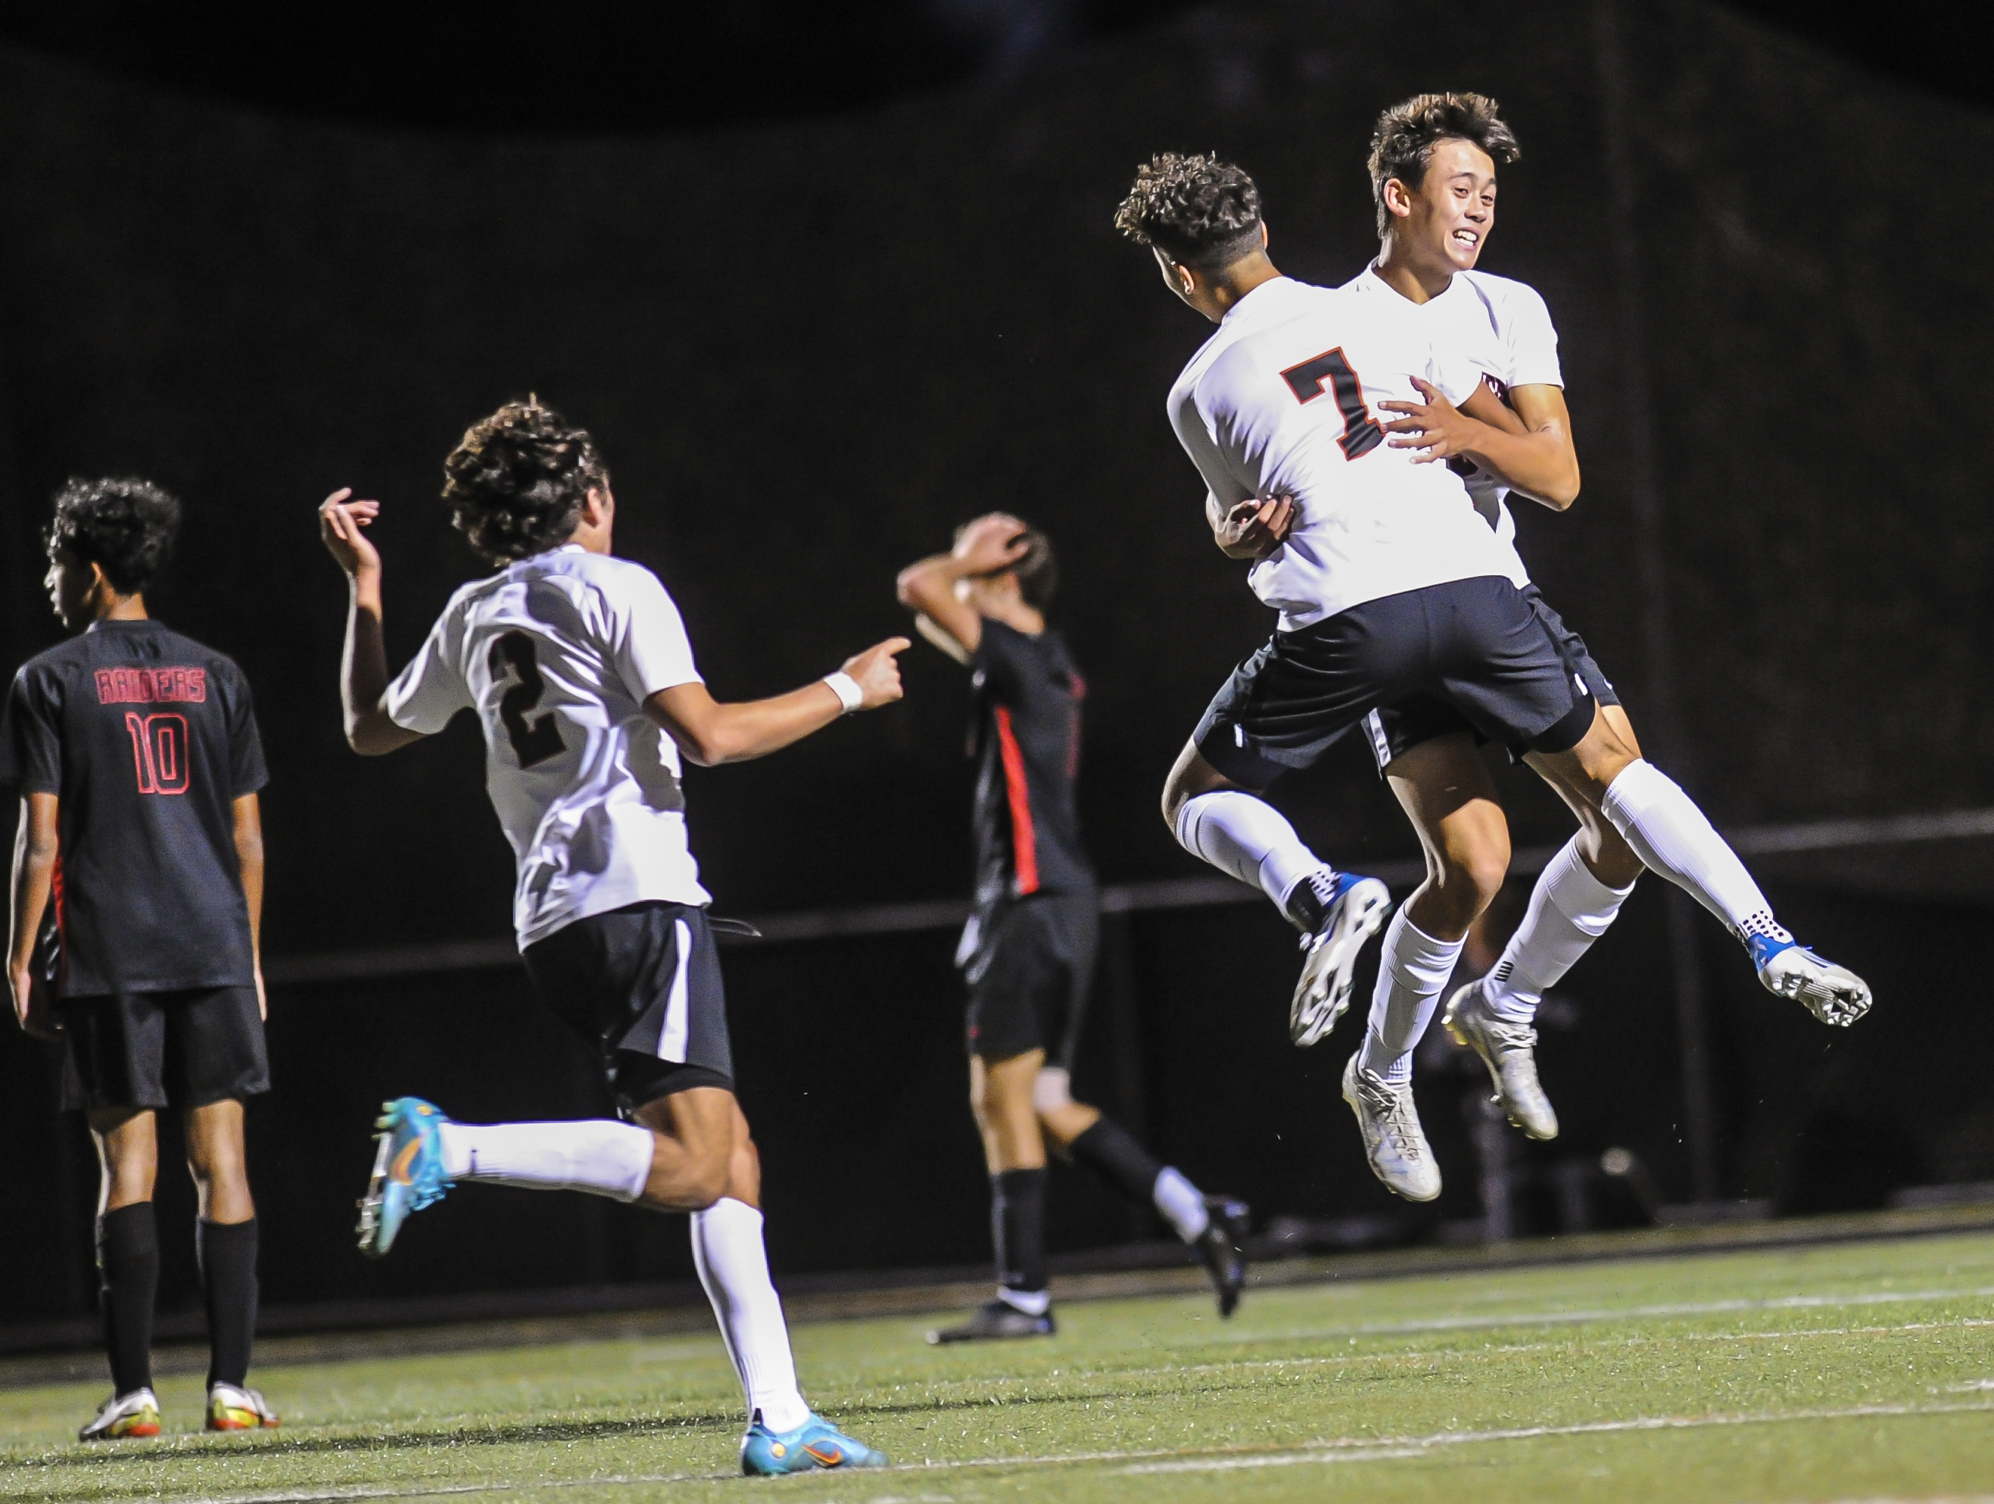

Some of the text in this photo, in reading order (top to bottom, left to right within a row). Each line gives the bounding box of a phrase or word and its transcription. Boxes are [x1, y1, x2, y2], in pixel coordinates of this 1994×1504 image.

[1280, 346, 1386, 461] 7
[125, 712, 189, 795] 10
[488, 630, 567, 769] 2
